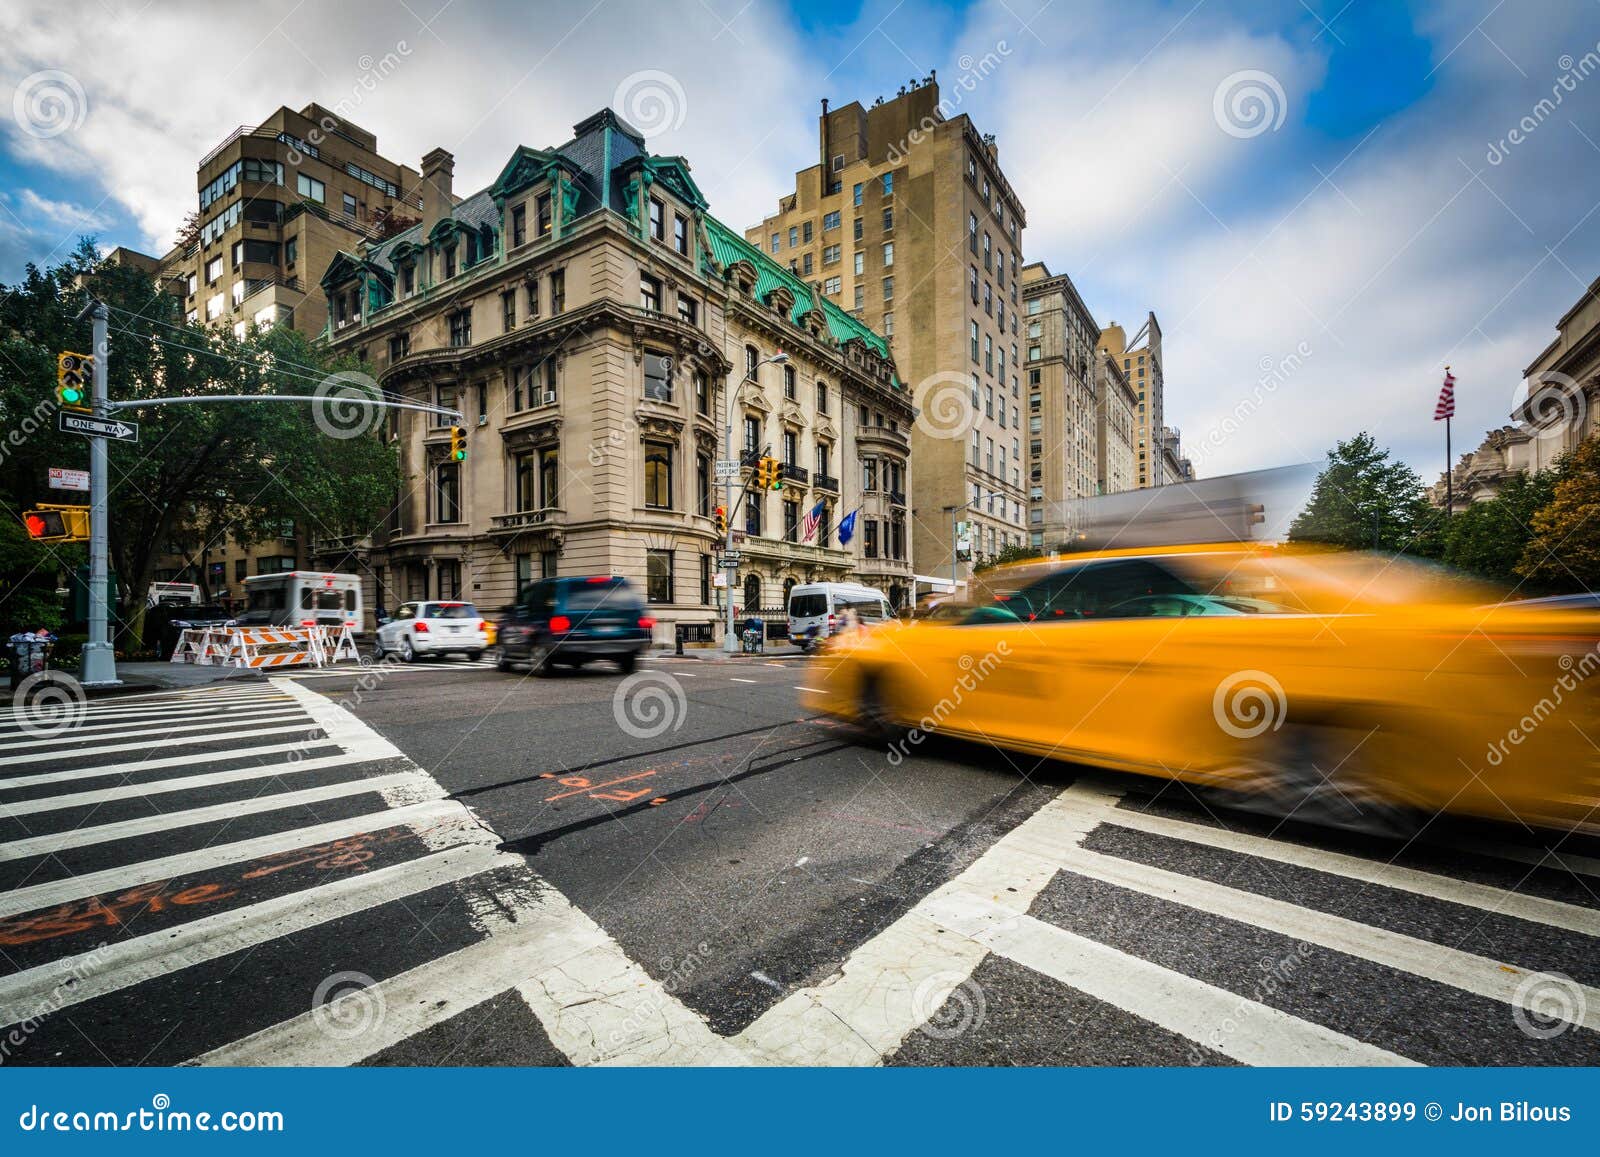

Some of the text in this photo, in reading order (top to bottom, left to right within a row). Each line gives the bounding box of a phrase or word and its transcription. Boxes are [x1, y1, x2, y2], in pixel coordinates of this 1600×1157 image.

[72, 419, 127, 435] ONE WAY
[50, 470, 62, 478] NO
